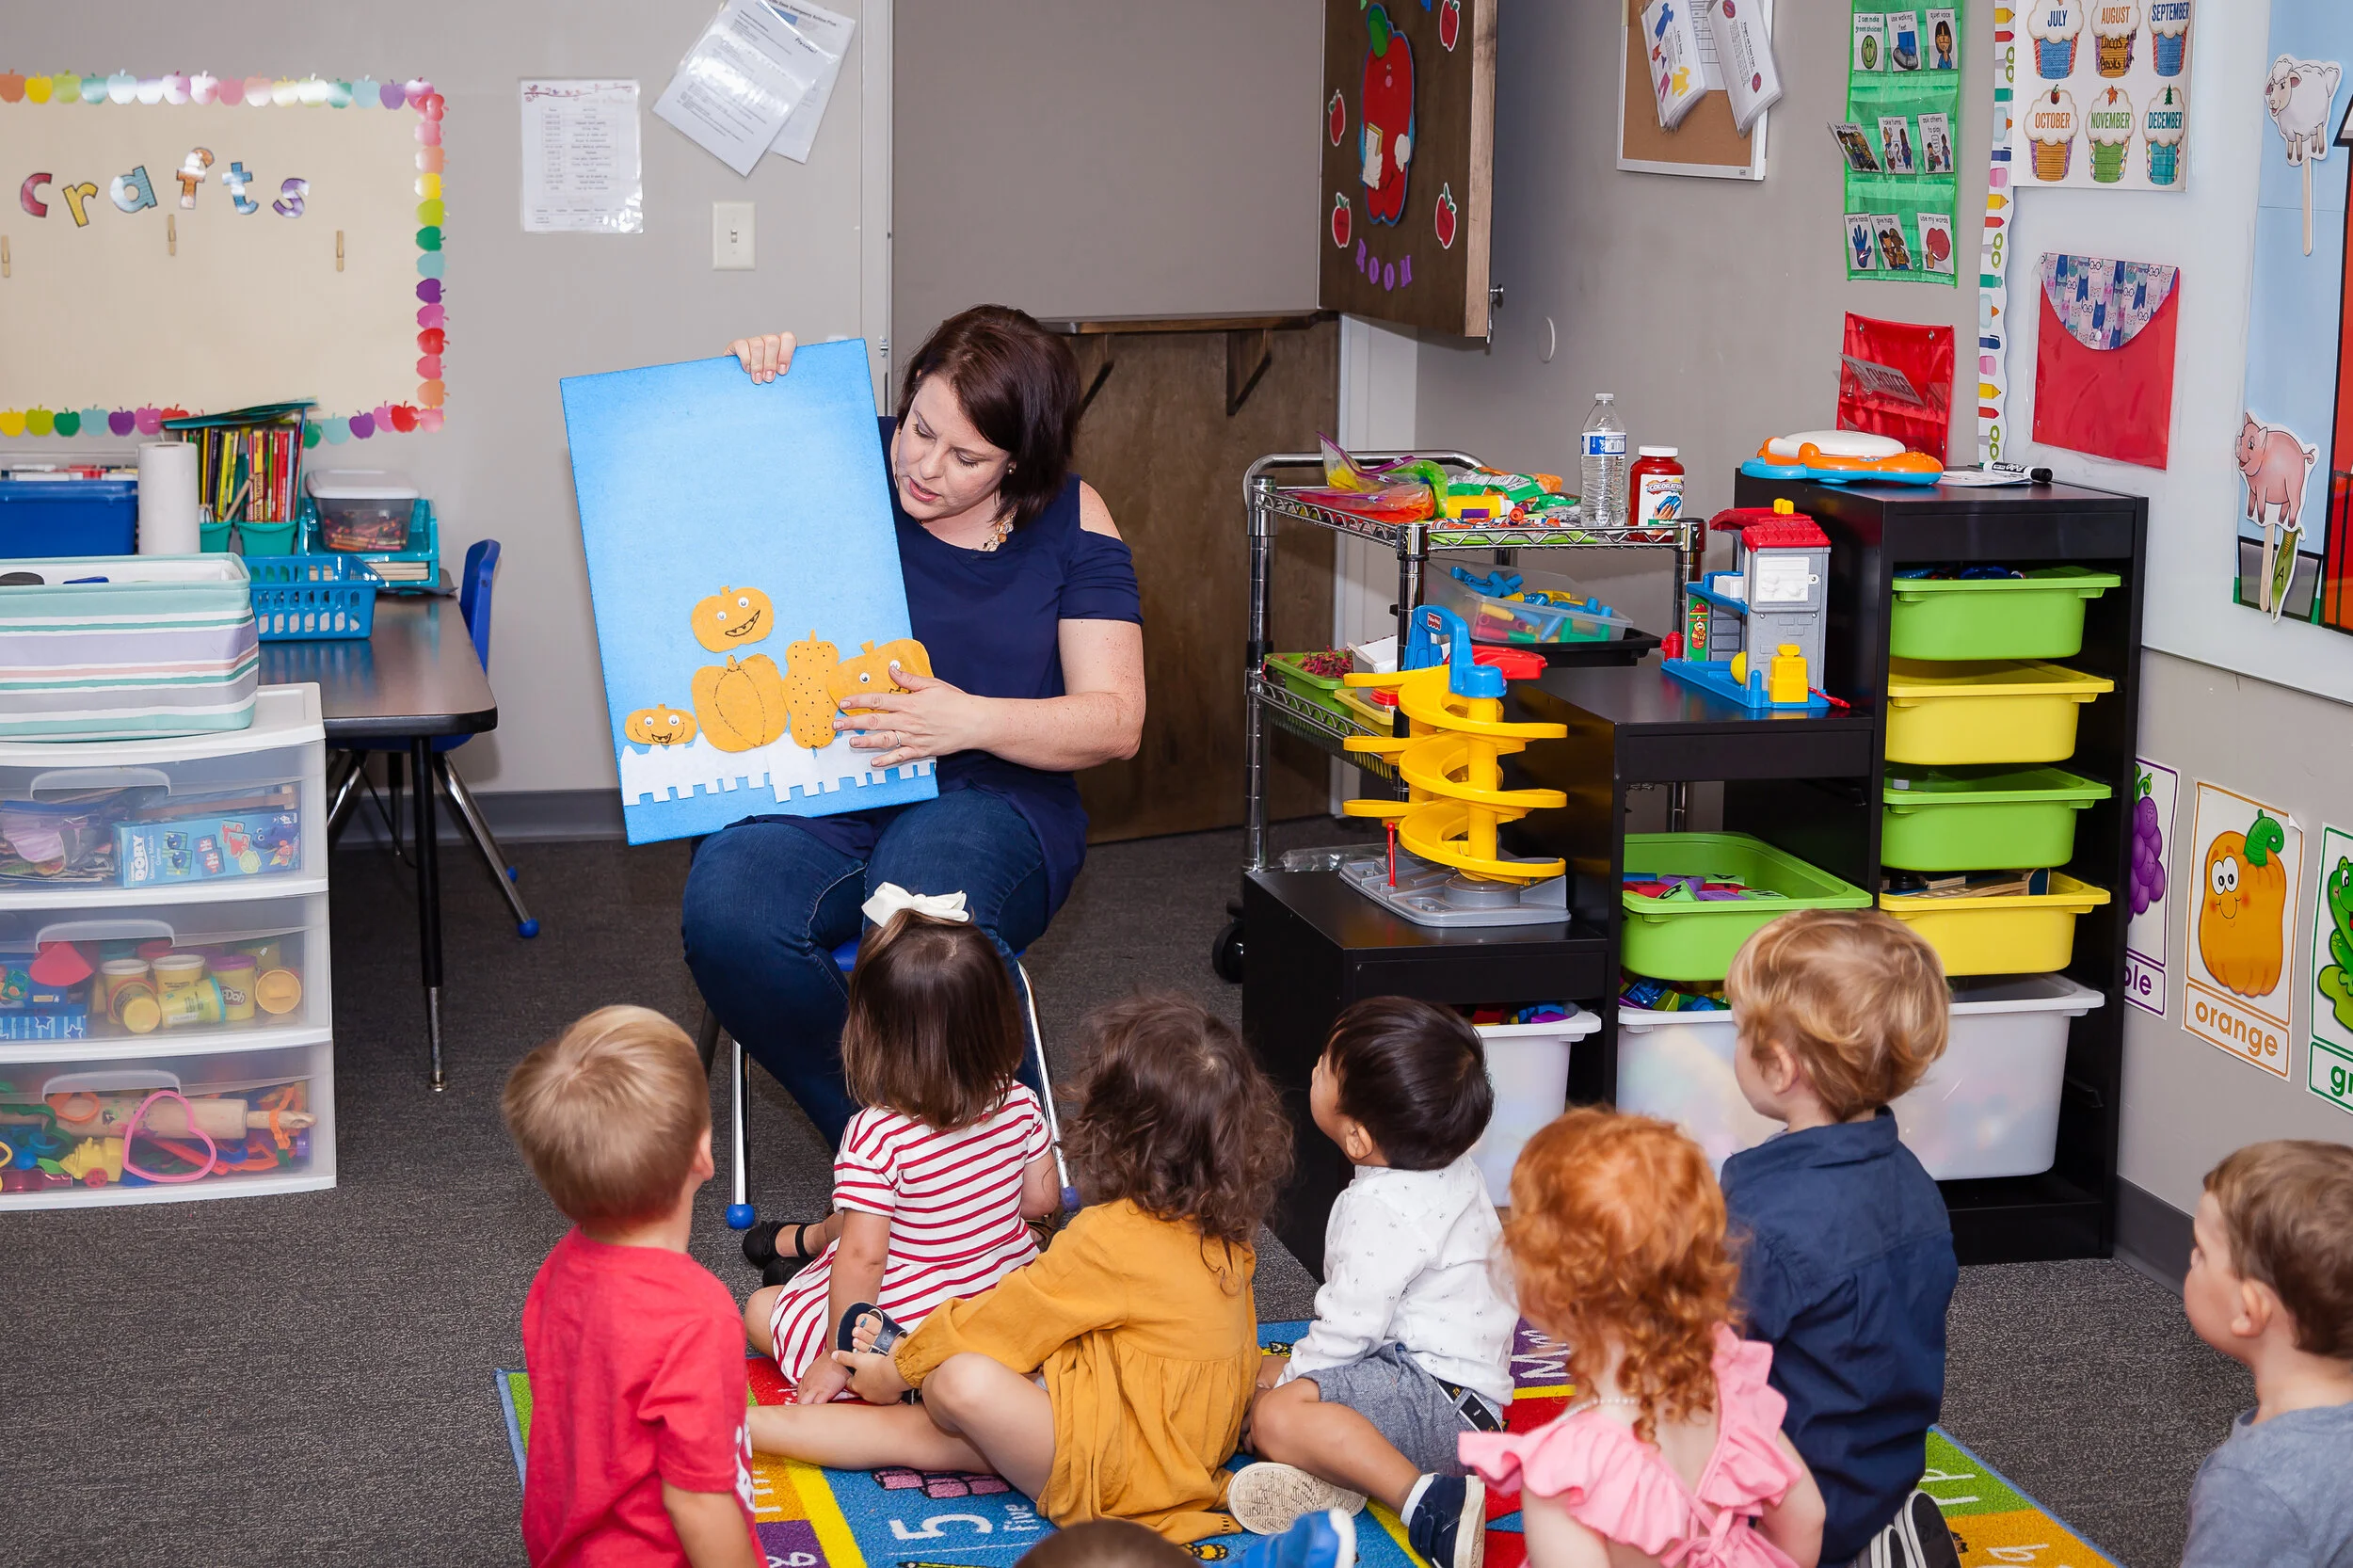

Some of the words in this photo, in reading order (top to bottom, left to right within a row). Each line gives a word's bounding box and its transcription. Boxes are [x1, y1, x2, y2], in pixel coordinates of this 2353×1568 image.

[2047, 10, 2068, 27] JULY
[2101, 7, 2131, 24] AUGUST
[2152, 2, 2189, 22] SEPTEMBER
[2035, 113, 2071, 129] OCTOBER
[2090, 113, 2131, 129] NOVEMBER
[2148, 112, 2183, 130] DECEMBER
[21, 147, 309, 227] crafts
[2274, 566, 2284, 587] A
[134, 834, 146, 882] DORY
[2195, 1000, 2279, 1057] orange
[890, 1513, 993, 1541] 5
[1004, 1503, 1041, 1532] five
